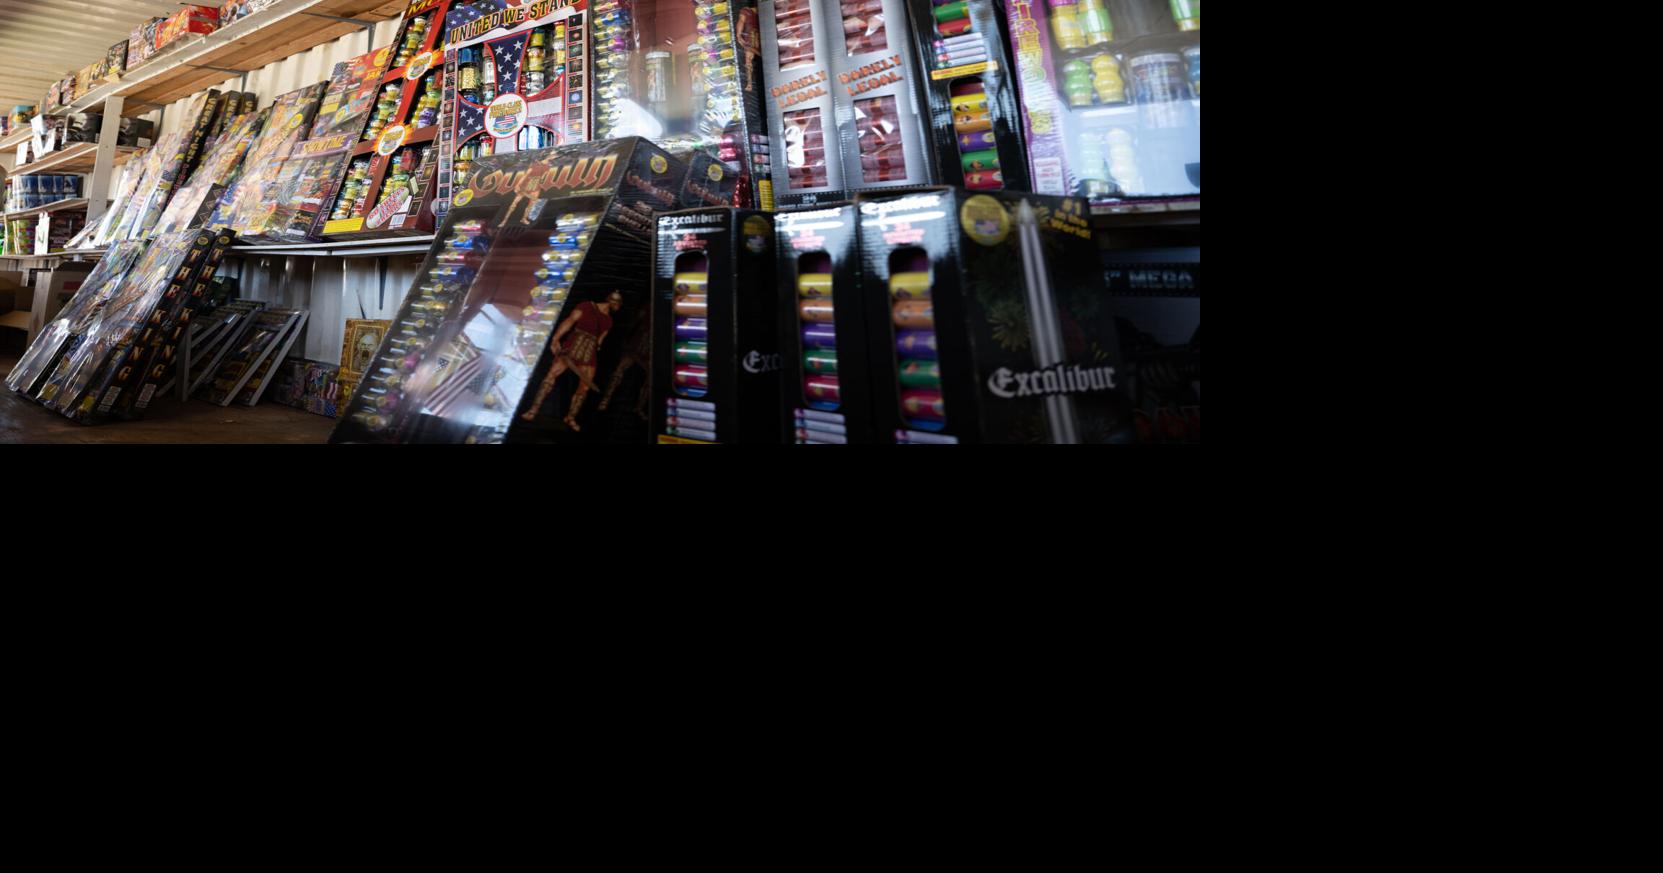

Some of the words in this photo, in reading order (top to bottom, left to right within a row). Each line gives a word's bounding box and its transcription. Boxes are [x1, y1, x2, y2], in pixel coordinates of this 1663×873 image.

[450, 12, 500, 44] UNITED
[503, 7, 525, 24] WE
[657, 213, 725, 226] Excalibur
[986, 364, 1116, 398] Excalibur
